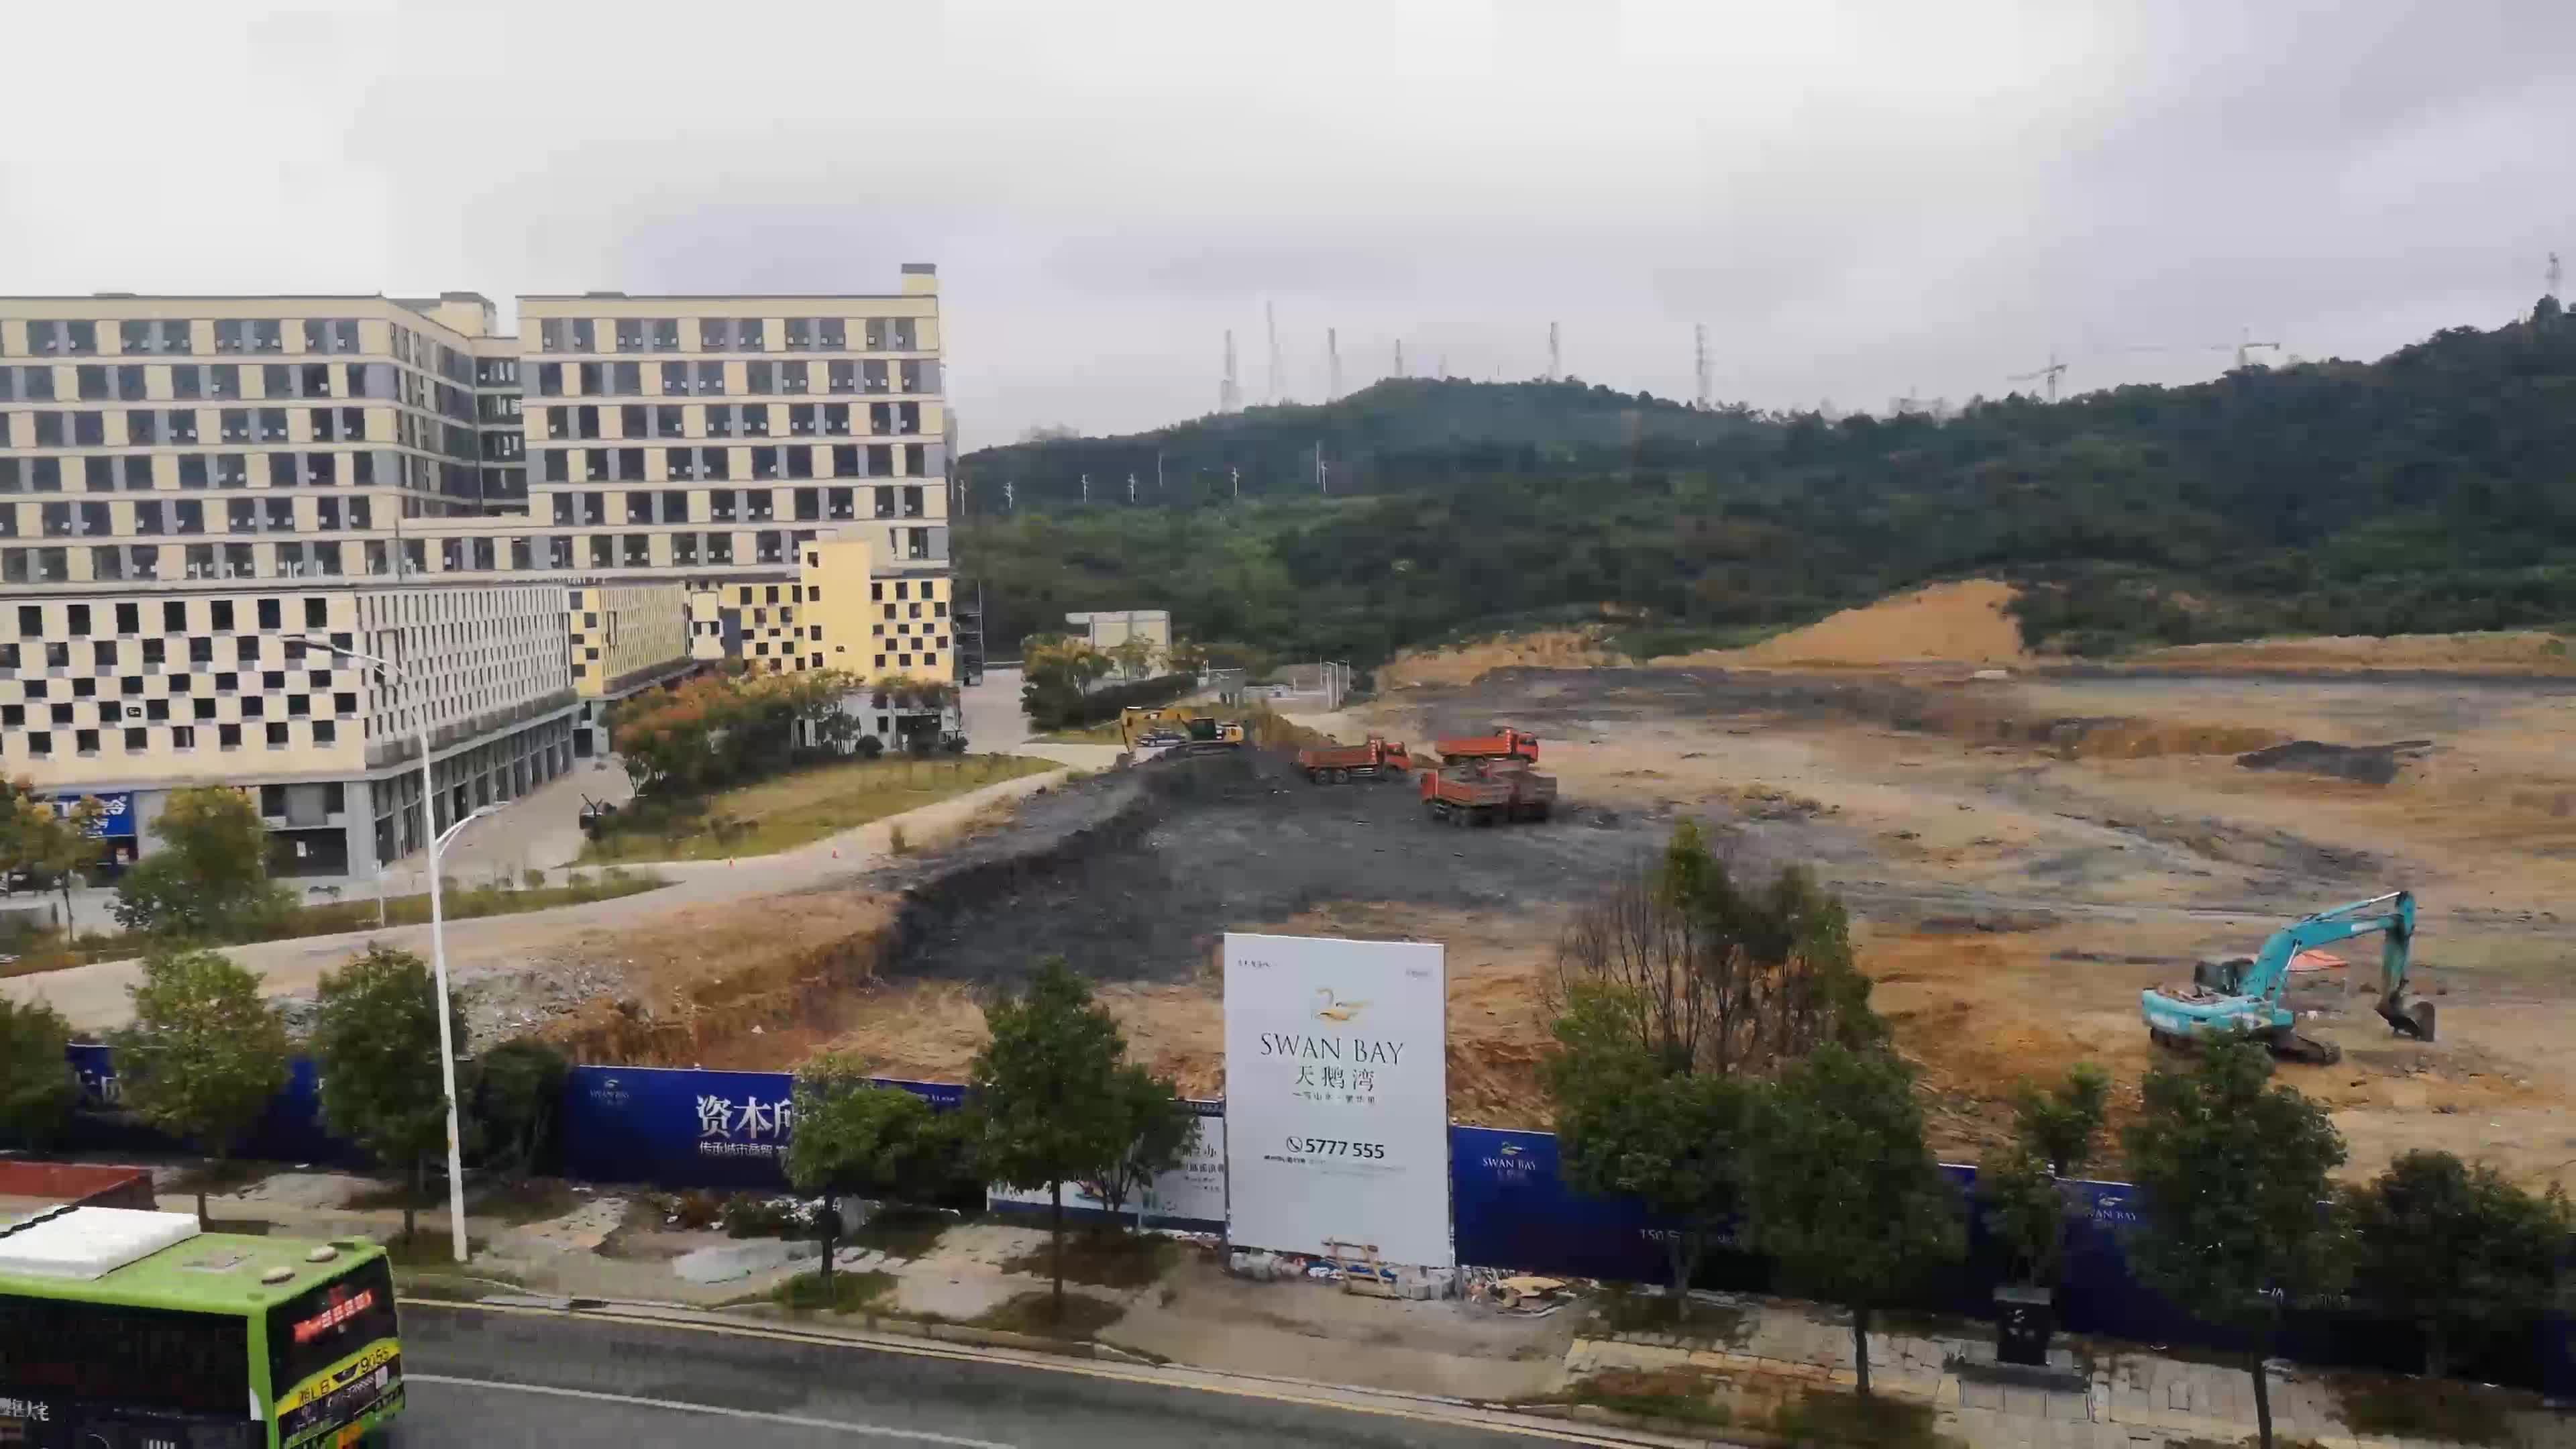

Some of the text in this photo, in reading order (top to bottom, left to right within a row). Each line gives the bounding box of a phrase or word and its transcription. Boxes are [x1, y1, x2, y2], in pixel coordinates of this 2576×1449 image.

[1260, 1032, 1403, 1065] SWAN BAY
[1295, 1065, 1375, 1091] 天鹅湾
[1304, 1138, 1385, 1159] 5777 555
